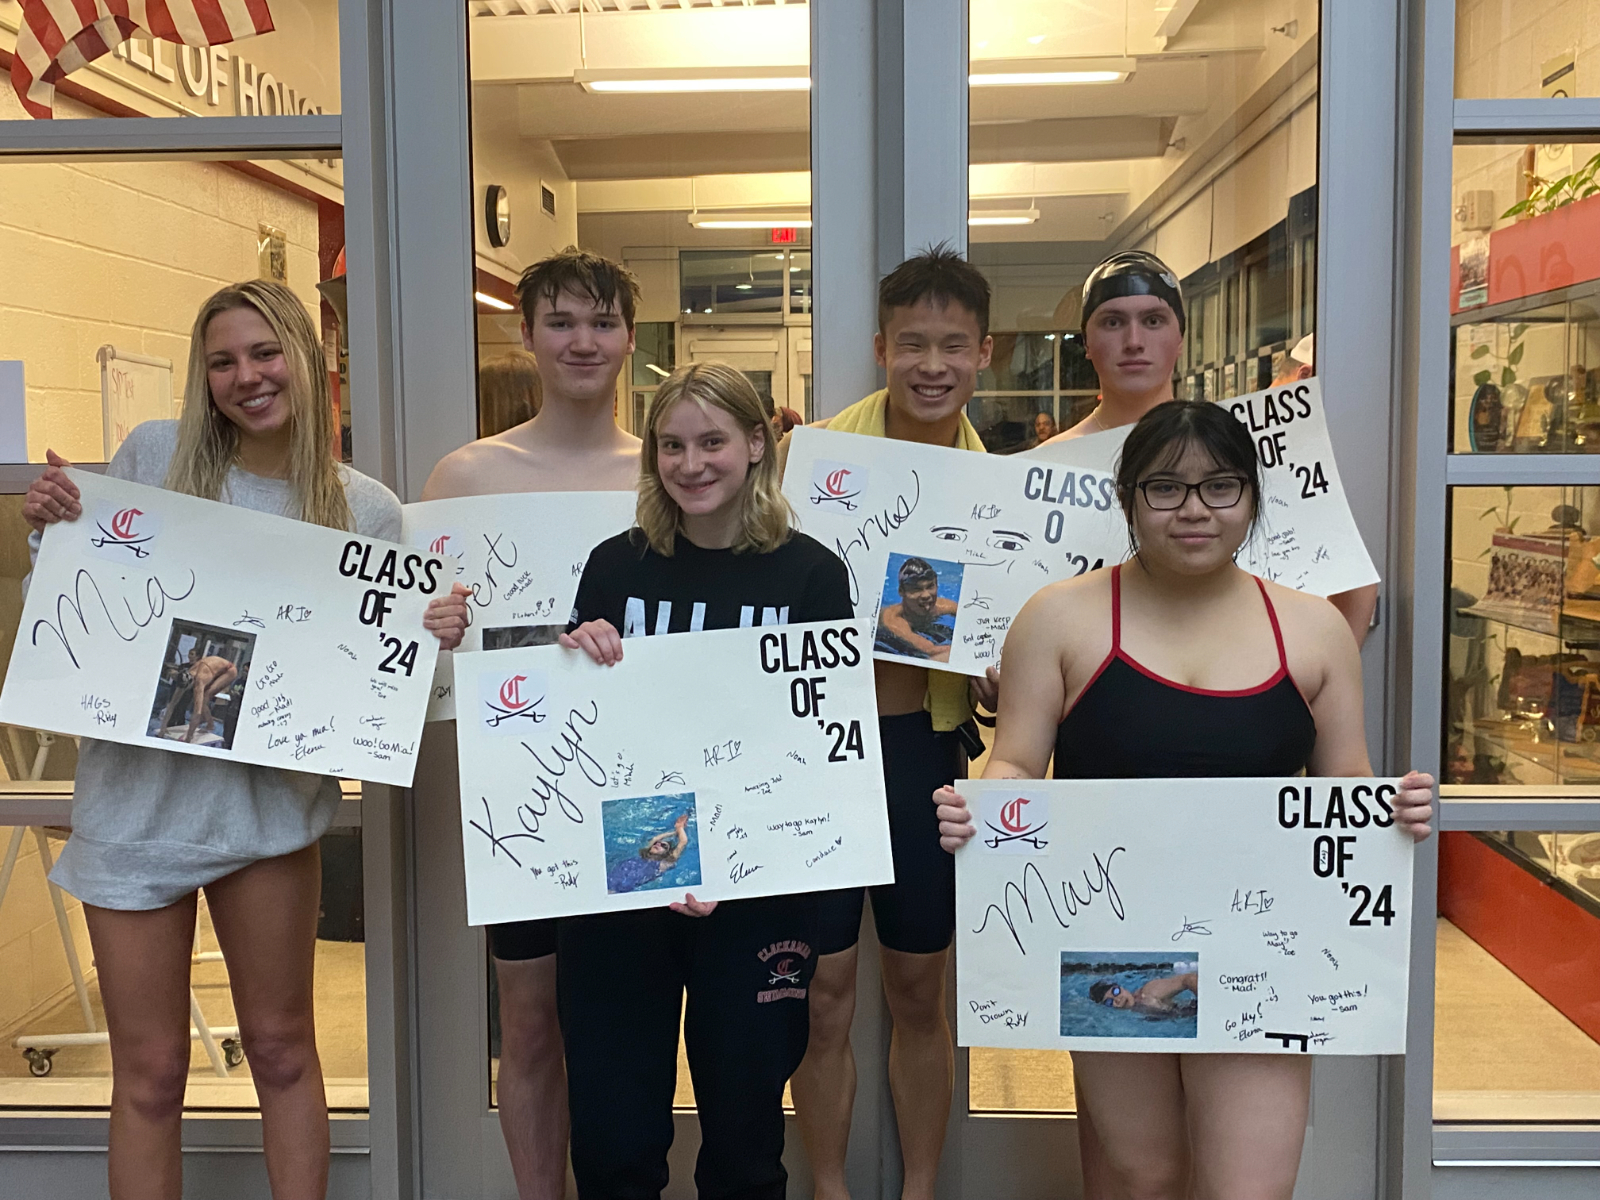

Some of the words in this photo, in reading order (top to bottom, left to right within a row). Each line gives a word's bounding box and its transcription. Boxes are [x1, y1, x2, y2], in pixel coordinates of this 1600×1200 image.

[180, 44, 228, 106] OF
[1258, 431, 1287, 469] OF
[1024, 466, 1112, 512] CLASS
[1289, 461, 1329, 500] '24
[1044, 509, 1065, 544] O
[339, 540, 443, 595] CLASS
[32, 568, 195, 670] Mia
[358, 589, 396, 628] OF
[378, 632, 419, 677] '24
[759, 626, 861, 674] CLASS
[789, 676, 827, 718] OF
[817, 719, 865, 763] '24
[469, 700, 607, 868] Kaylyn
[1278, 784, 1397, 829] CLASS
[1313, 835, 1357, 878] OF
[972, 846, 1126, 956] May
[1341, 882, 1396, 927] '24
[1219, 971, 1268, 985] Congrats!
[1307, 994, 1327, 1004] You
[1343, 984, 1368, 998] this!
[1225, 1019, 1237, 1032] Go
